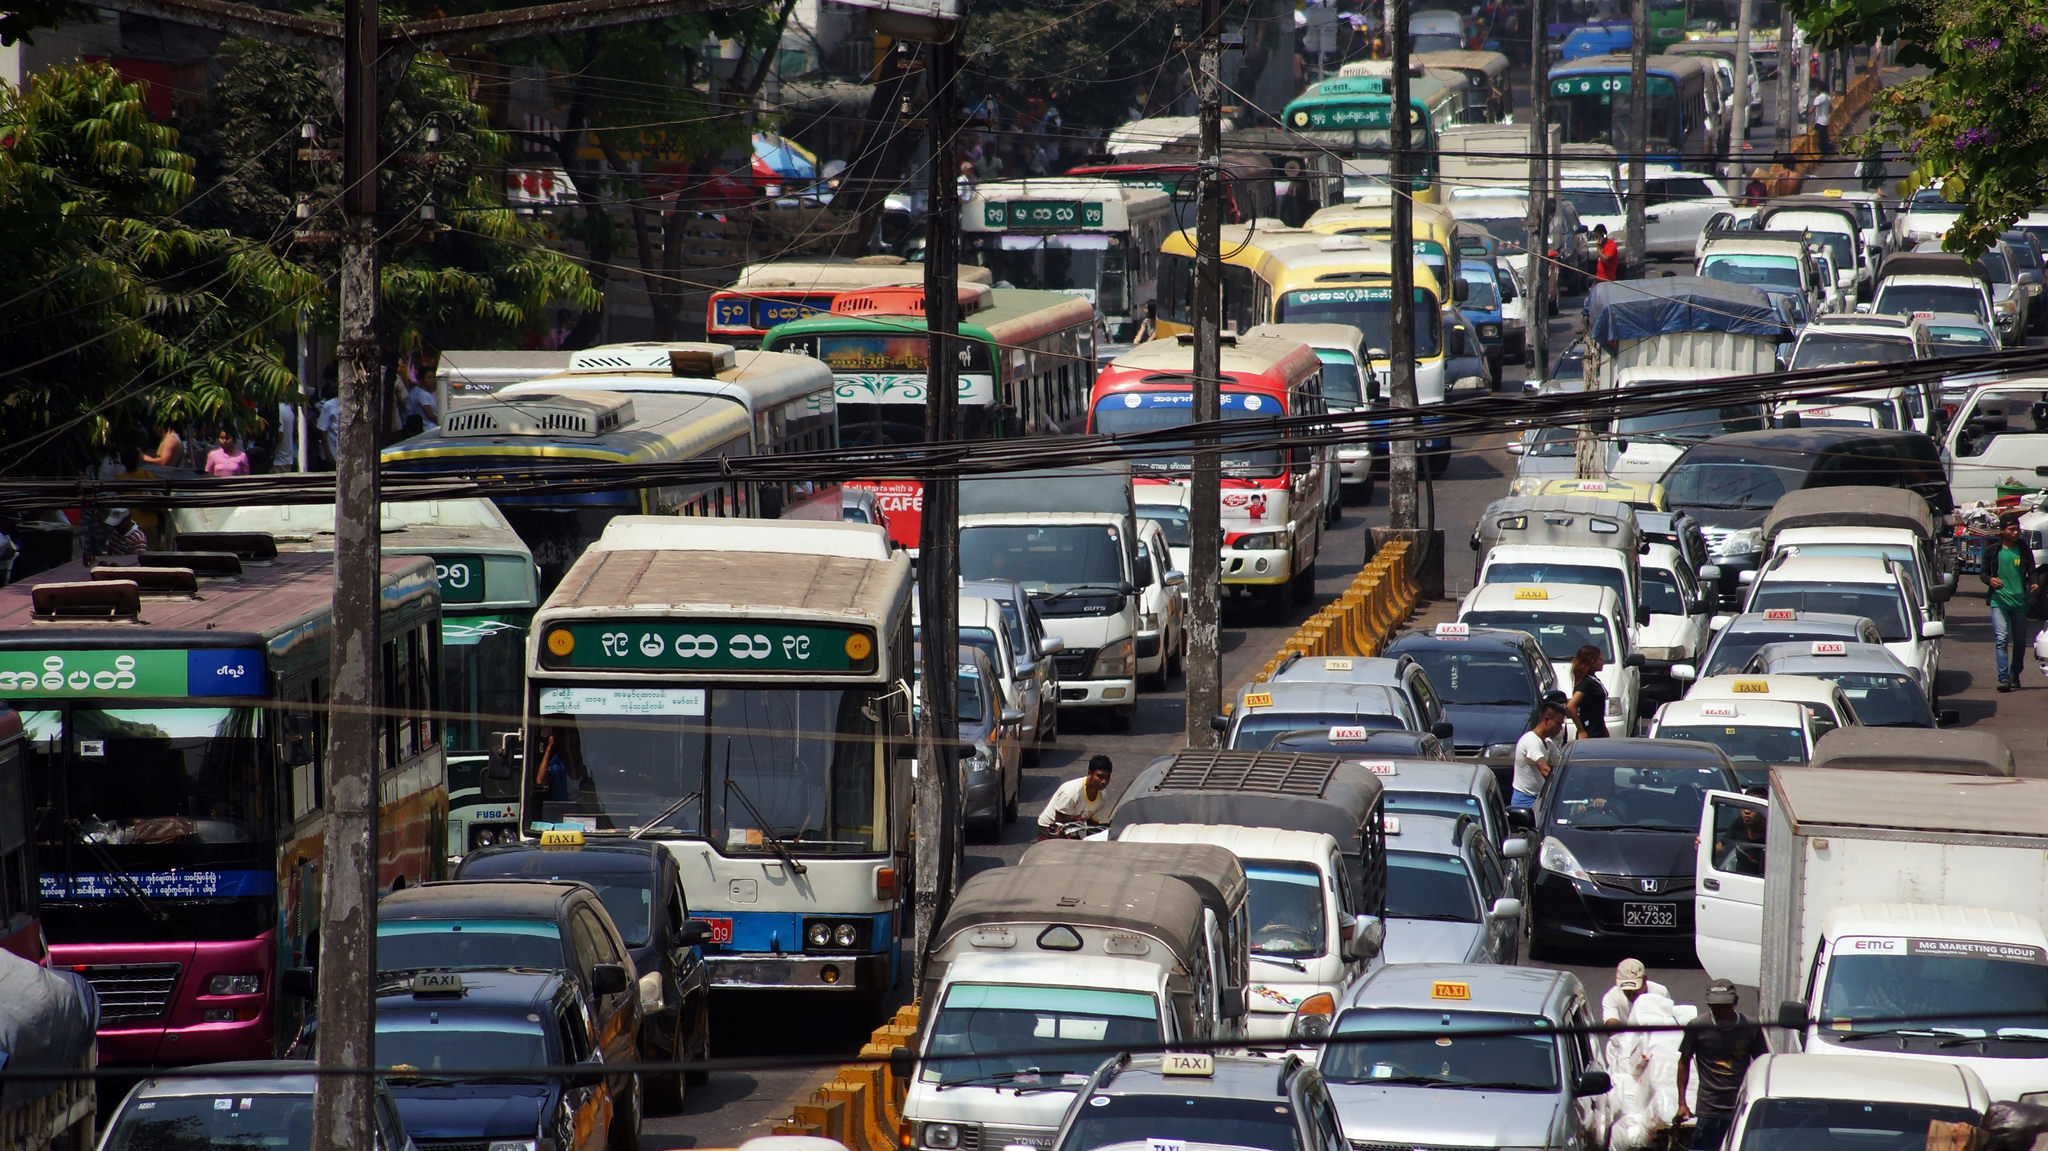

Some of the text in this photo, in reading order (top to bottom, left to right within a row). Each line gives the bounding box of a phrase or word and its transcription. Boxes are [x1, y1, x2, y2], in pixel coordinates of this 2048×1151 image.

[889, 484, 906, 492] with
[1768, 610, 1791, 619] TAXI
[1442, 625, 1466, 633] TAXI
[1818, 643, 1842, 652] TAXI
[1739, 684, 1761, 693] TAXI
[1247, 694, 1269, 705] TAXI
[1336, 729, 1362, 738] TAXI
[547, 835, 575, 844] TAXI
[1627, 911, 1673, 925] 2K-7332
[1855, 941, 1895, 949] EMG
[1939, 942, 1998, 953] MARKETING
[2000, 947, 2036, 957] GROUP
[420, 976, 455, 986] TAXI
[1437, 985, 1466, 997] TAXI
[1172, 1057, 1208, 1069] TAXI
[1014, 1137, 1055, 1147] TOWNA
